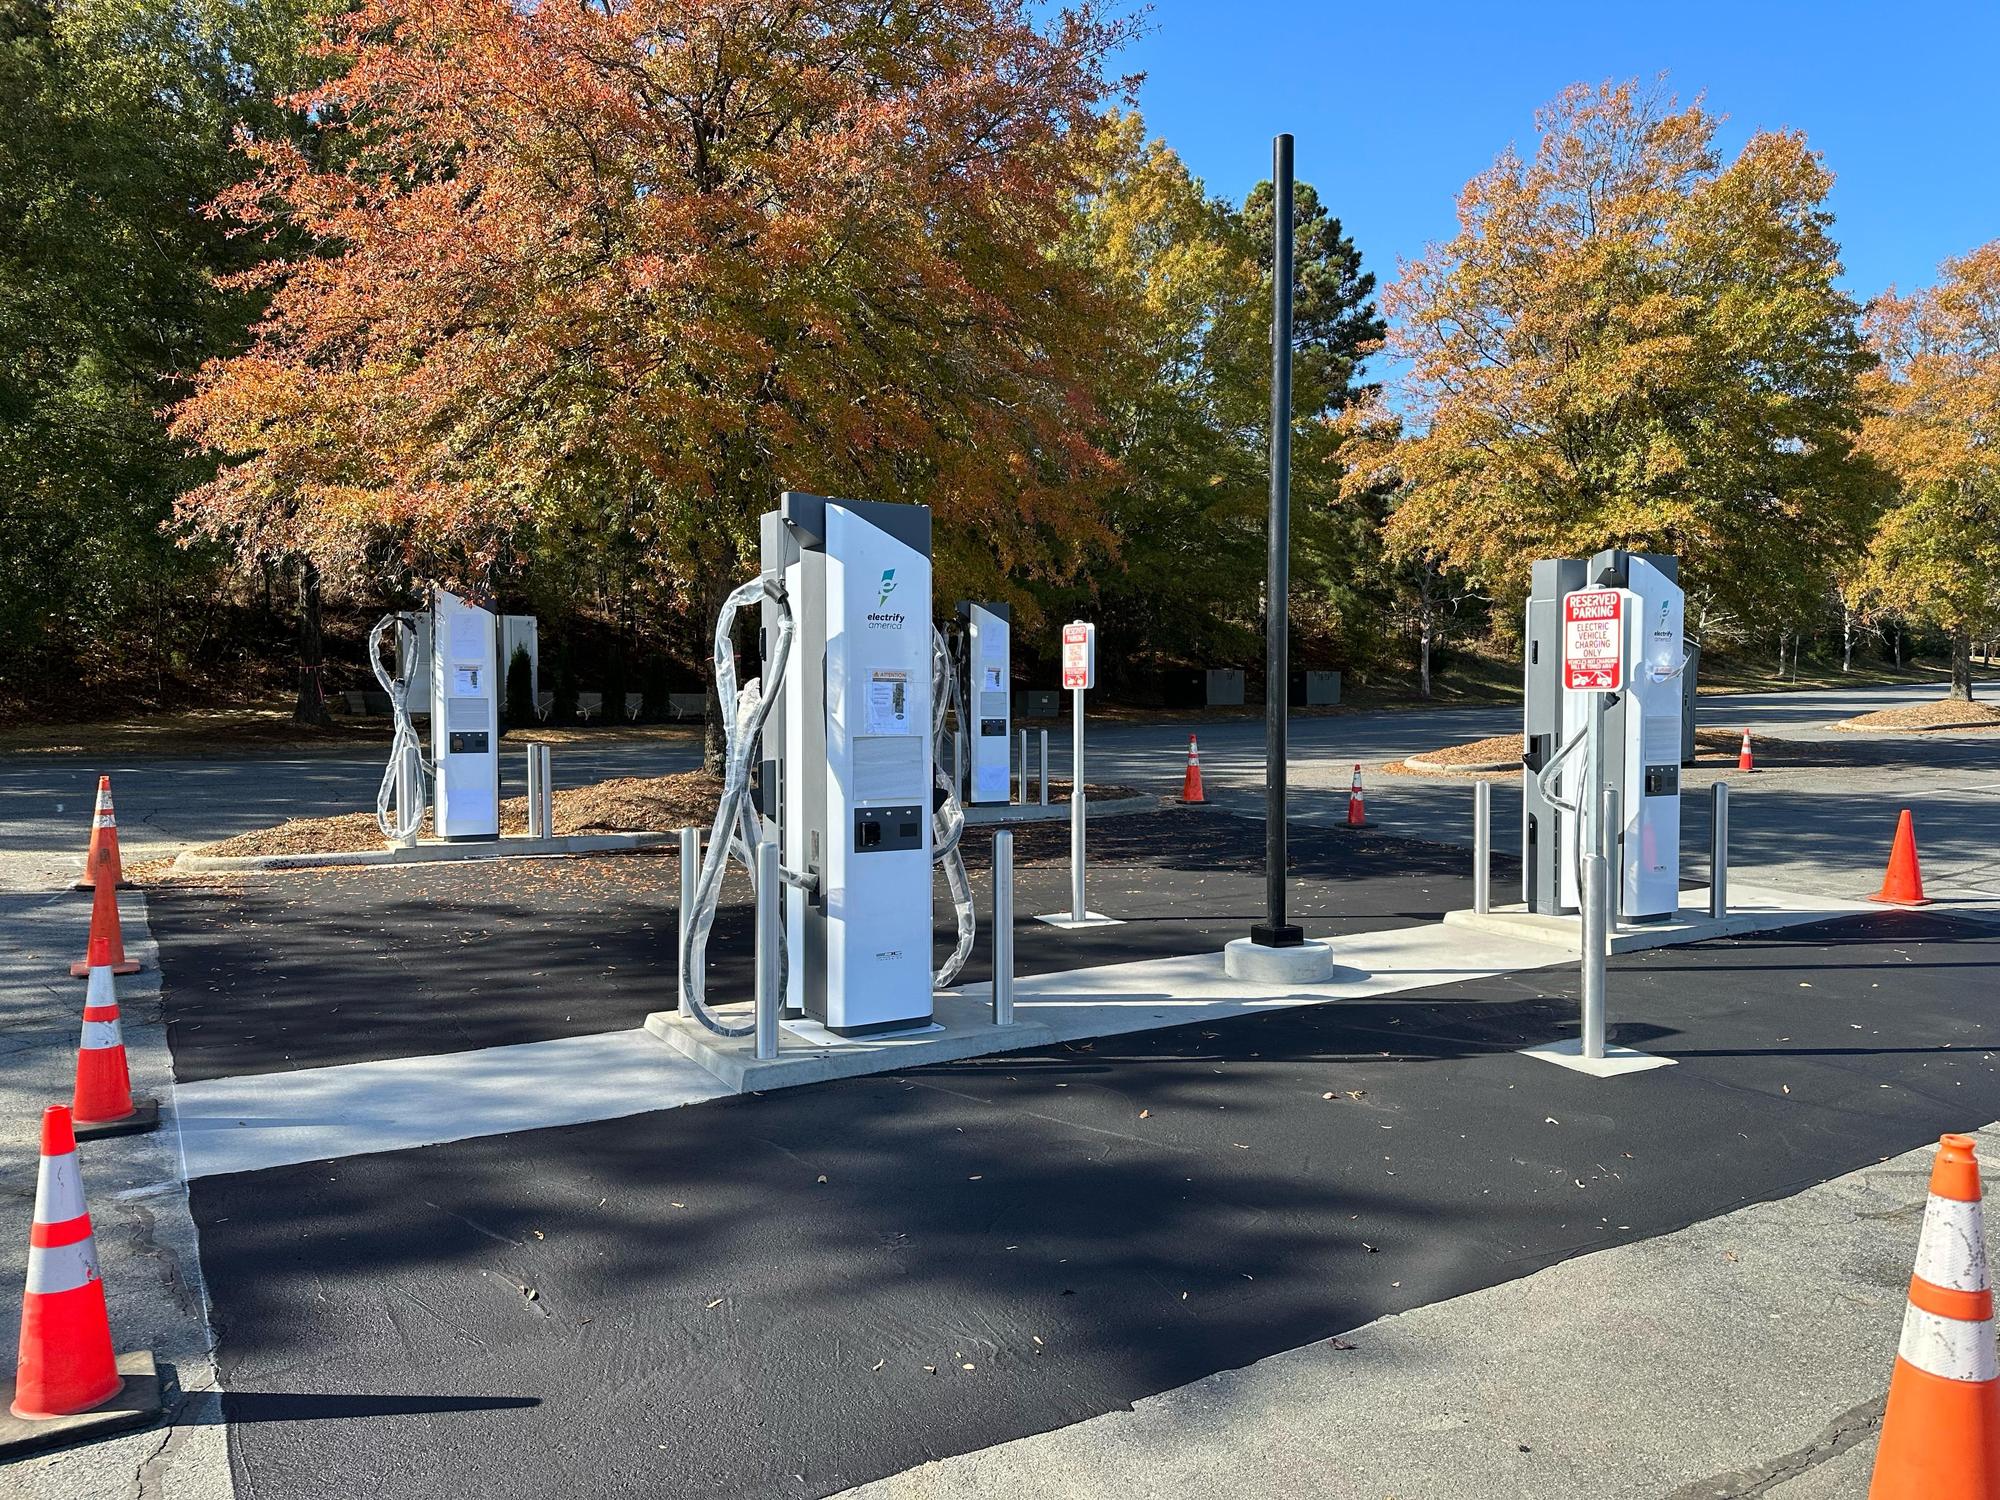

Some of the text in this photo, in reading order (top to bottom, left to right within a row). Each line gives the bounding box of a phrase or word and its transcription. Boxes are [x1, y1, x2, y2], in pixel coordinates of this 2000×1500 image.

[1570, 593, 1617, 608] RESERVED
[1573, 606, 1614, 619] PARKING
[867, 613, 905, 623] electrify
[868, 622, 902, 630] america
[1577, 622, 1609, 632] ELECTRIC
[1578, 631, 1607, 640] VEHICLE
[1654, 630, 1673, 638] electrify
[1575, 640, 1611, 649] CHARGING
[1583, 649, 1602, 657] ONLY
